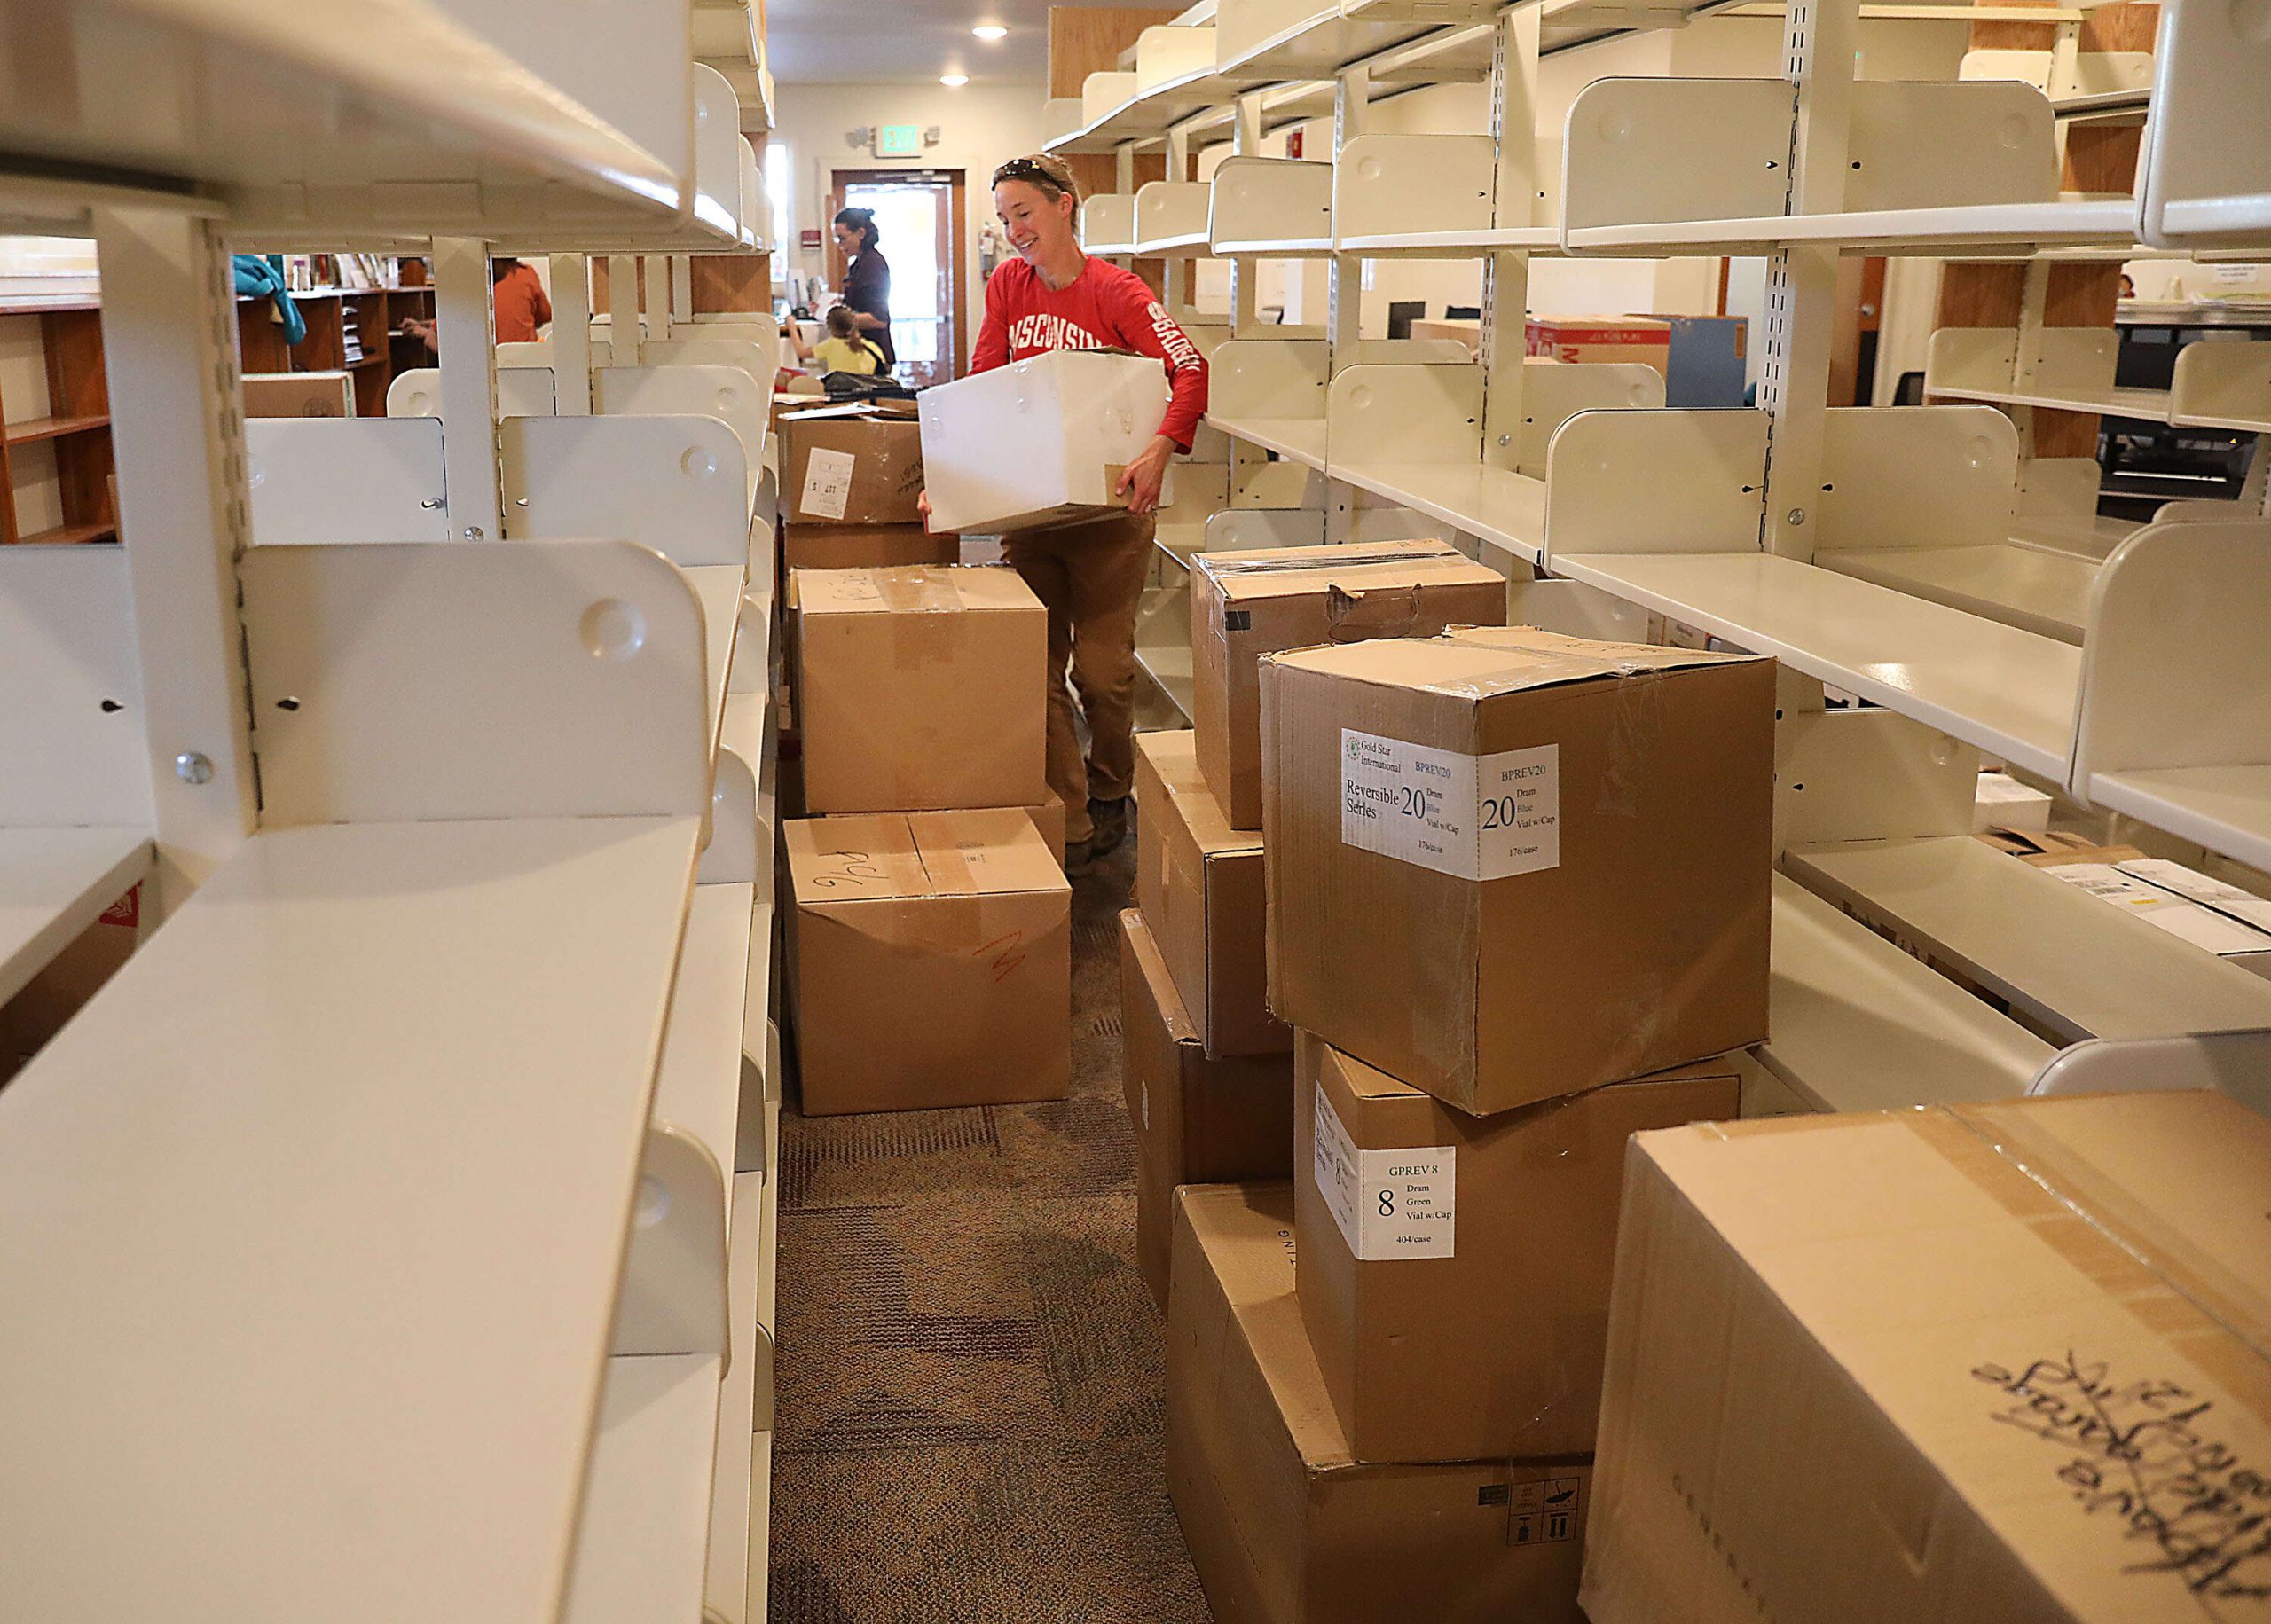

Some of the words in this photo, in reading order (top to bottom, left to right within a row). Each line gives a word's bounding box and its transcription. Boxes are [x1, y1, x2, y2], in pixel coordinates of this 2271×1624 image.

[1009, 313, 1103, 351] ISCONSI
[1361, 740, 1376, 753] Gold
[1377, 743, 1391, 756] Star
[1361, 755, 1402, 773] International
[1415, 760, 1451, 779] BPREV20
[1501, 764, 1545, 781] BPREV20
[1347, 778, 1400, 806] Reversible
[1426, 788, 1443, 799] Dram
[1516, 788, 1536, 798] Dram
[1347, 798, 1377, 820] Series
[1401, 786, 1426, 820] 20
[1481, 796, 1515, 830] 20
[1426, 817, 1440, 828] Vial
[1516, 820, 1532, 829] Vial
[1389, 1165, 1430, 1177] GPREV
[1432, 1165, 1439, 1175] 8
[1407, 1184, 1430, 1193] Dram
[1378, 1189, 1395, 1217] 8
[1406, 1197, 1431, 1206] Green
[1406, 1212, 1424, 1220] Vial
[1425, 1211, 1452, 1221] w/Cap
[1396, 1235, 1432, 1244] 404/case
